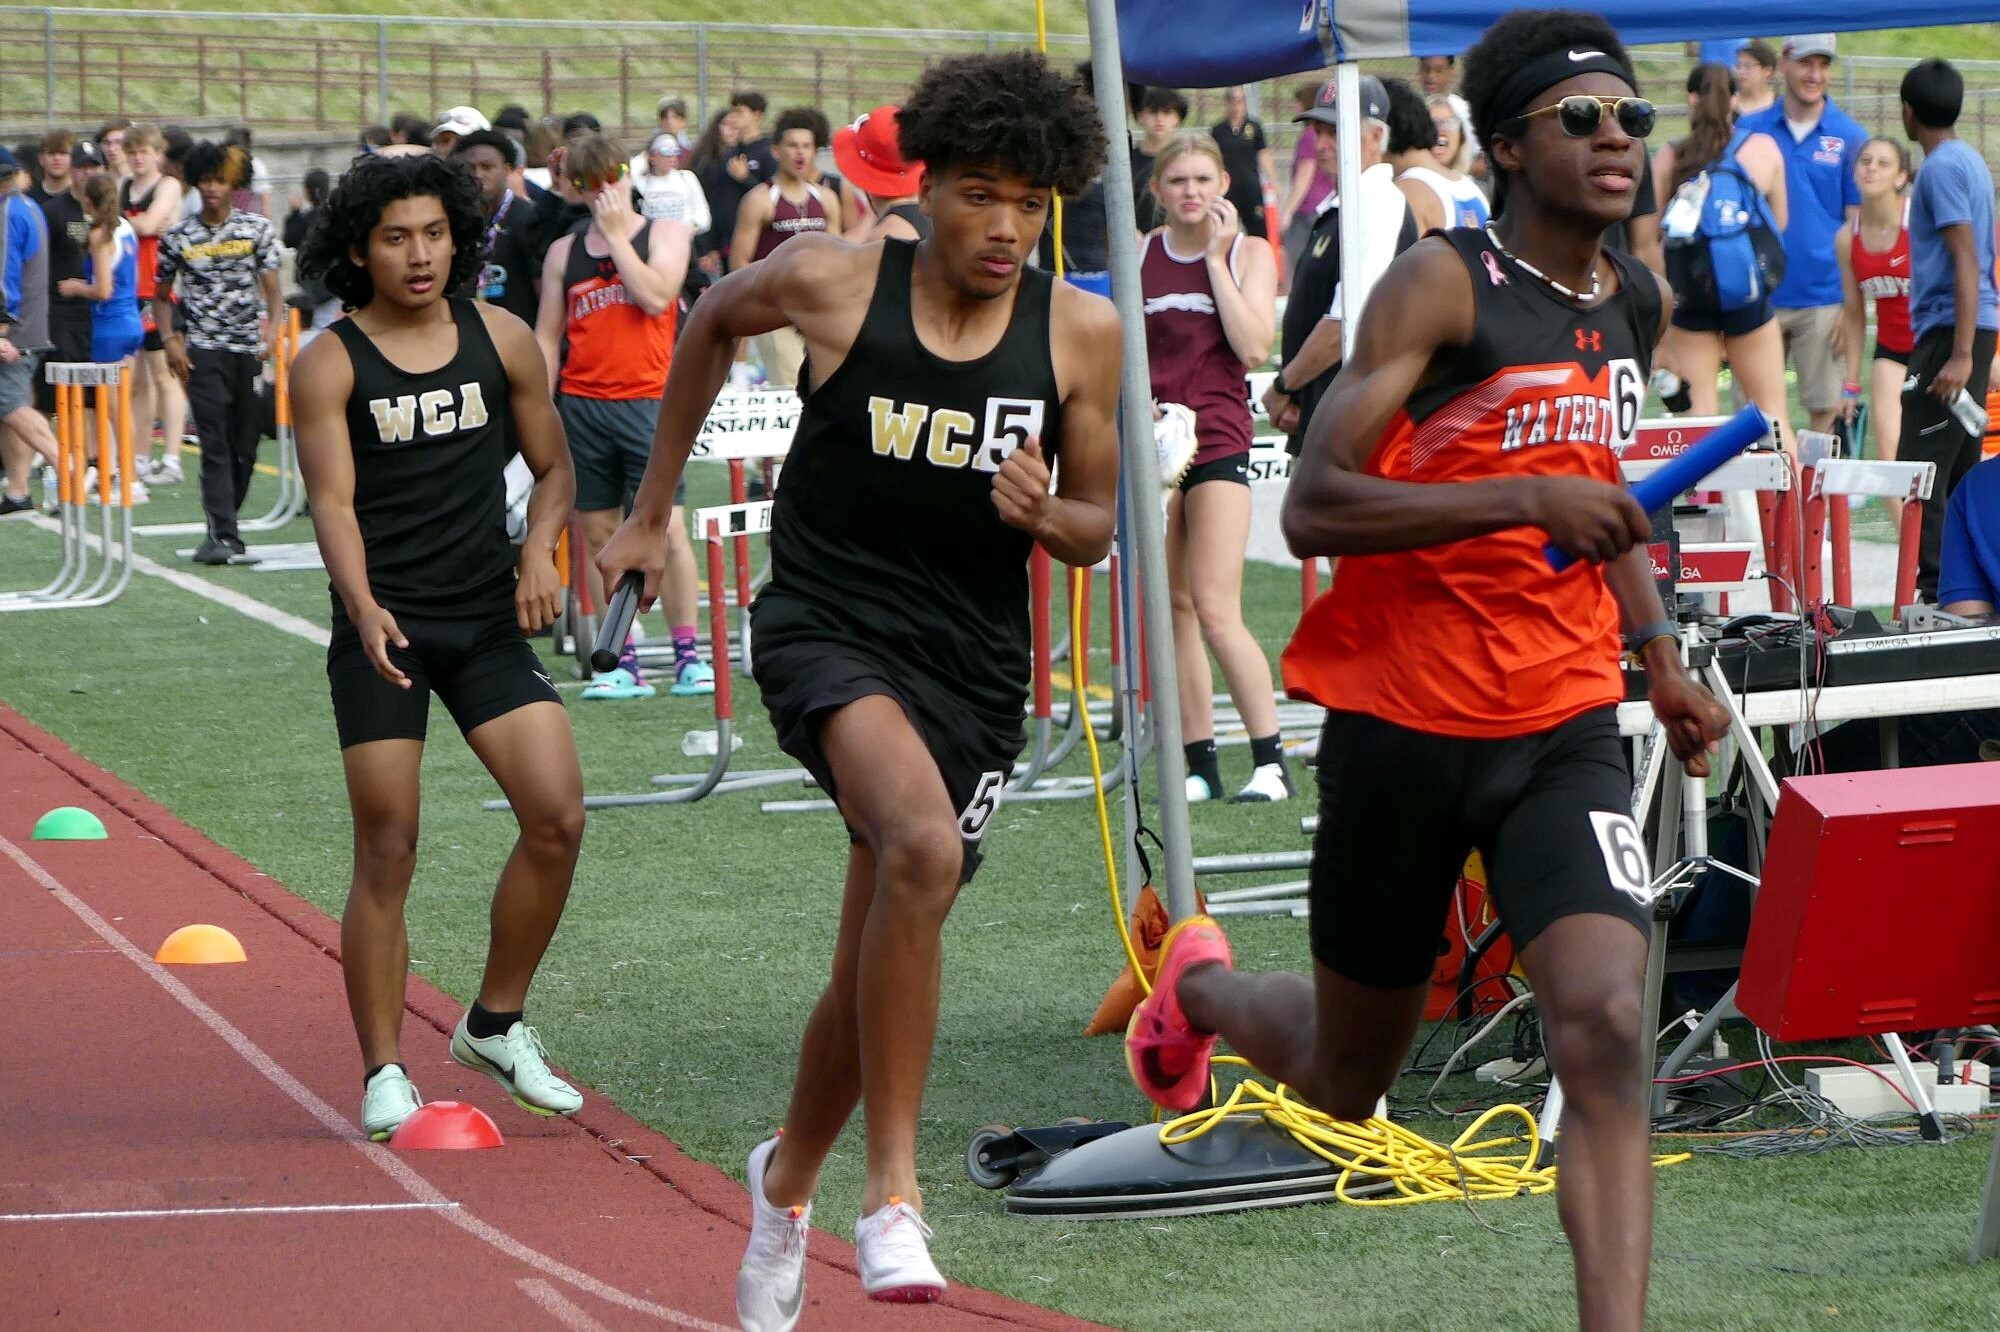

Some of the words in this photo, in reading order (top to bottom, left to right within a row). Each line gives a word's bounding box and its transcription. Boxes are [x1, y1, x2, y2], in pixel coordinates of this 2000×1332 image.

[369, 382, 489, 443] WCA
[868, 396, 985, 470] WC
[1614, 366, 1638, 441] 6
[1866, 638, 1910, 651] OMEGA
[961, 776, 1001, 834] 5
[1606, 820, 1645, 888] 6
